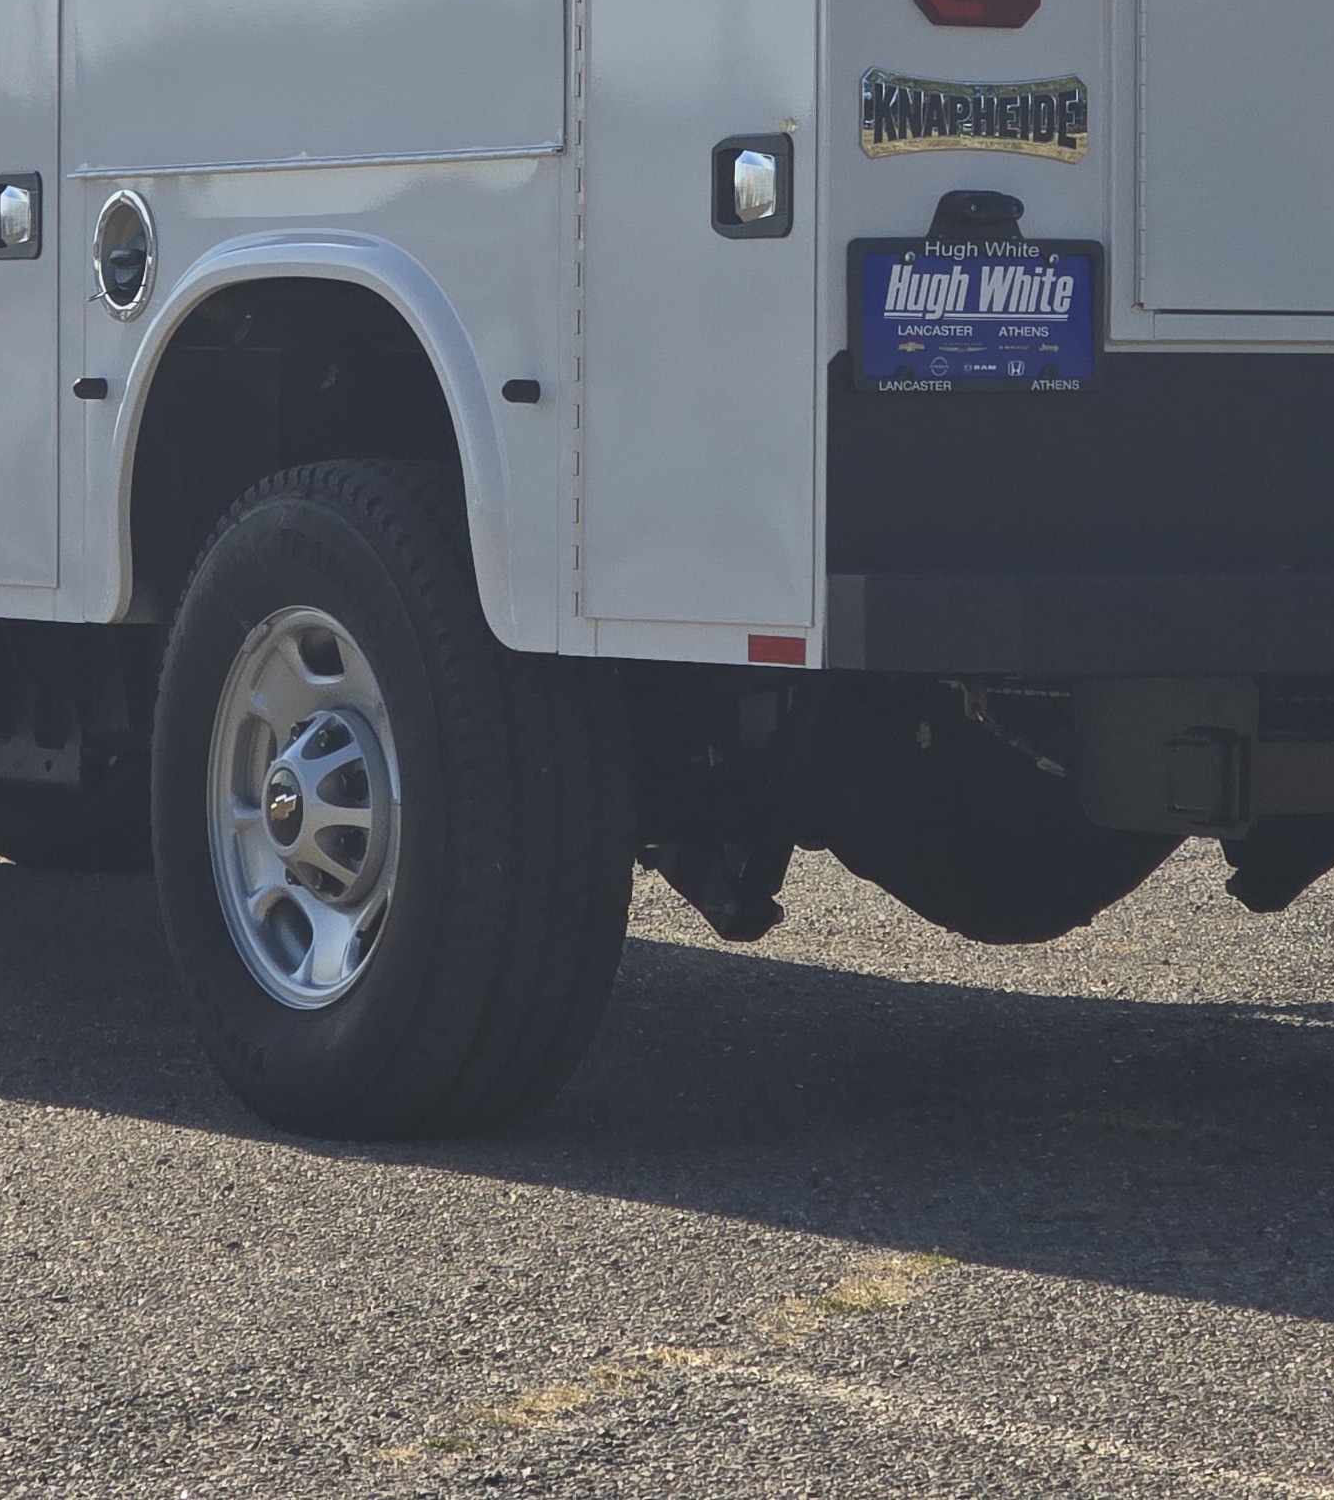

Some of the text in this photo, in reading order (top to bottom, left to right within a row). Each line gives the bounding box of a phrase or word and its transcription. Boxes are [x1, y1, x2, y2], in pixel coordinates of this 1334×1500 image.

[872, 81, 1079, 150] KNAPHEIDE
[925, 241, 1040, 259] Hugh White
[884, 264, 1074, 320] Hugh White
[898, 325, 973, 337] LANCASTER
[999, 326, 1049, 338] ATHENS
[879, 380, 952, 392] LANCASTER
[1031, 379, 1080, 391] ATHENS
